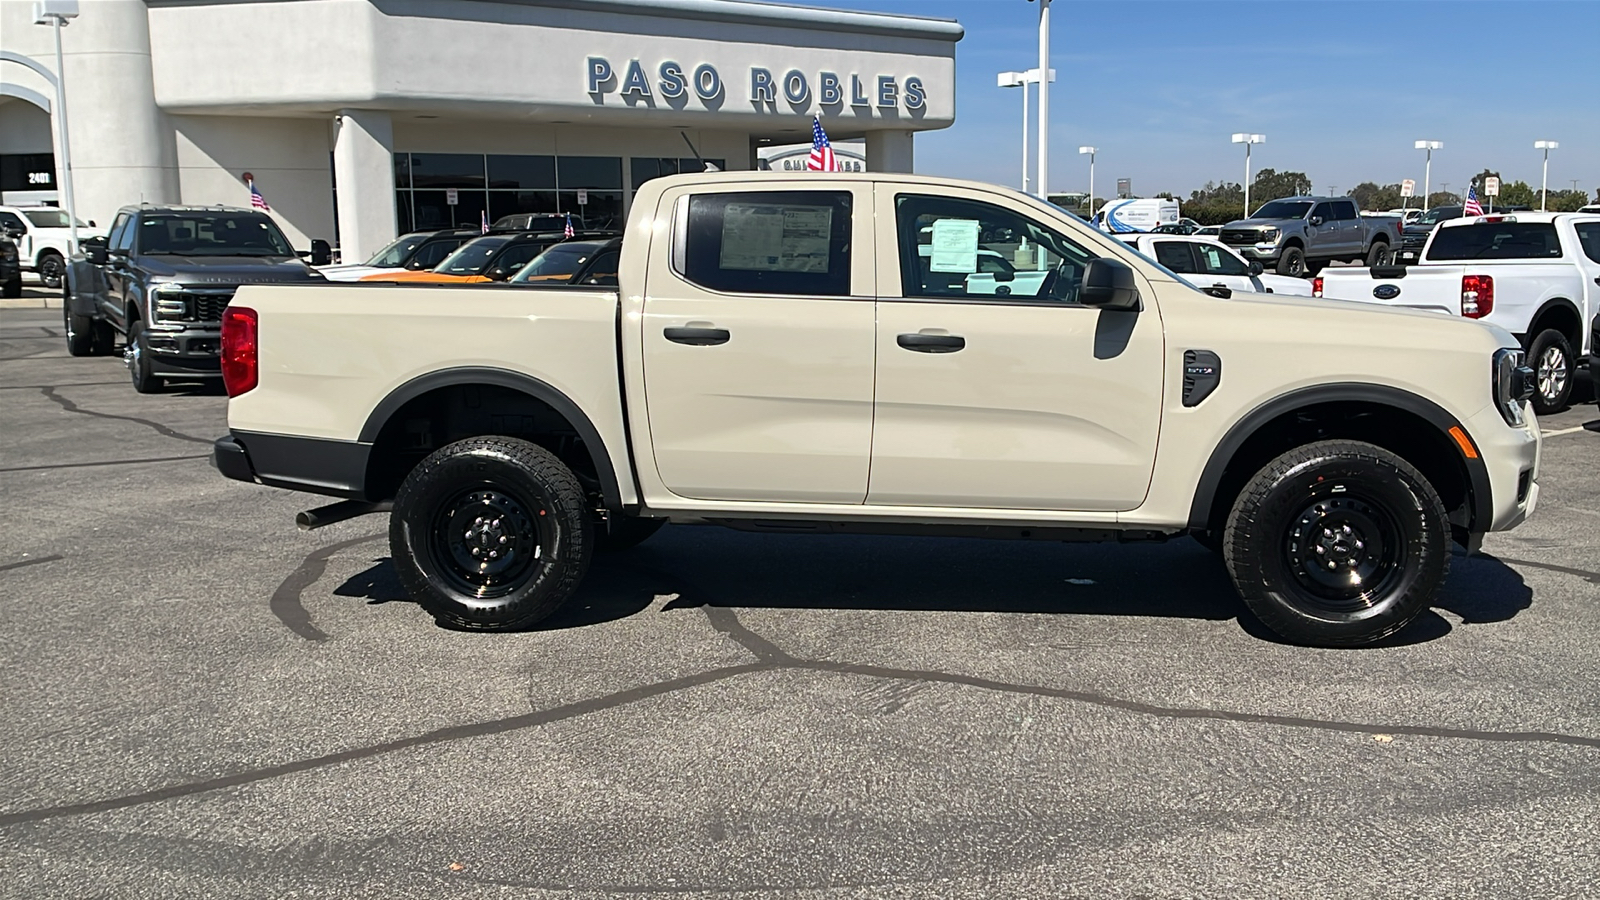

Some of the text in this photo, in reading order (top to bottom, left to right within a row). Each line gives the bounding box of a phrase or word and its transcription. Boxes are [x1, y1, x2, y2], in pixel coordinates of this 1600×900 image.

[586, 56, 926, 109] PASO ROBLES
[28, 172, 50, 184] 2401
